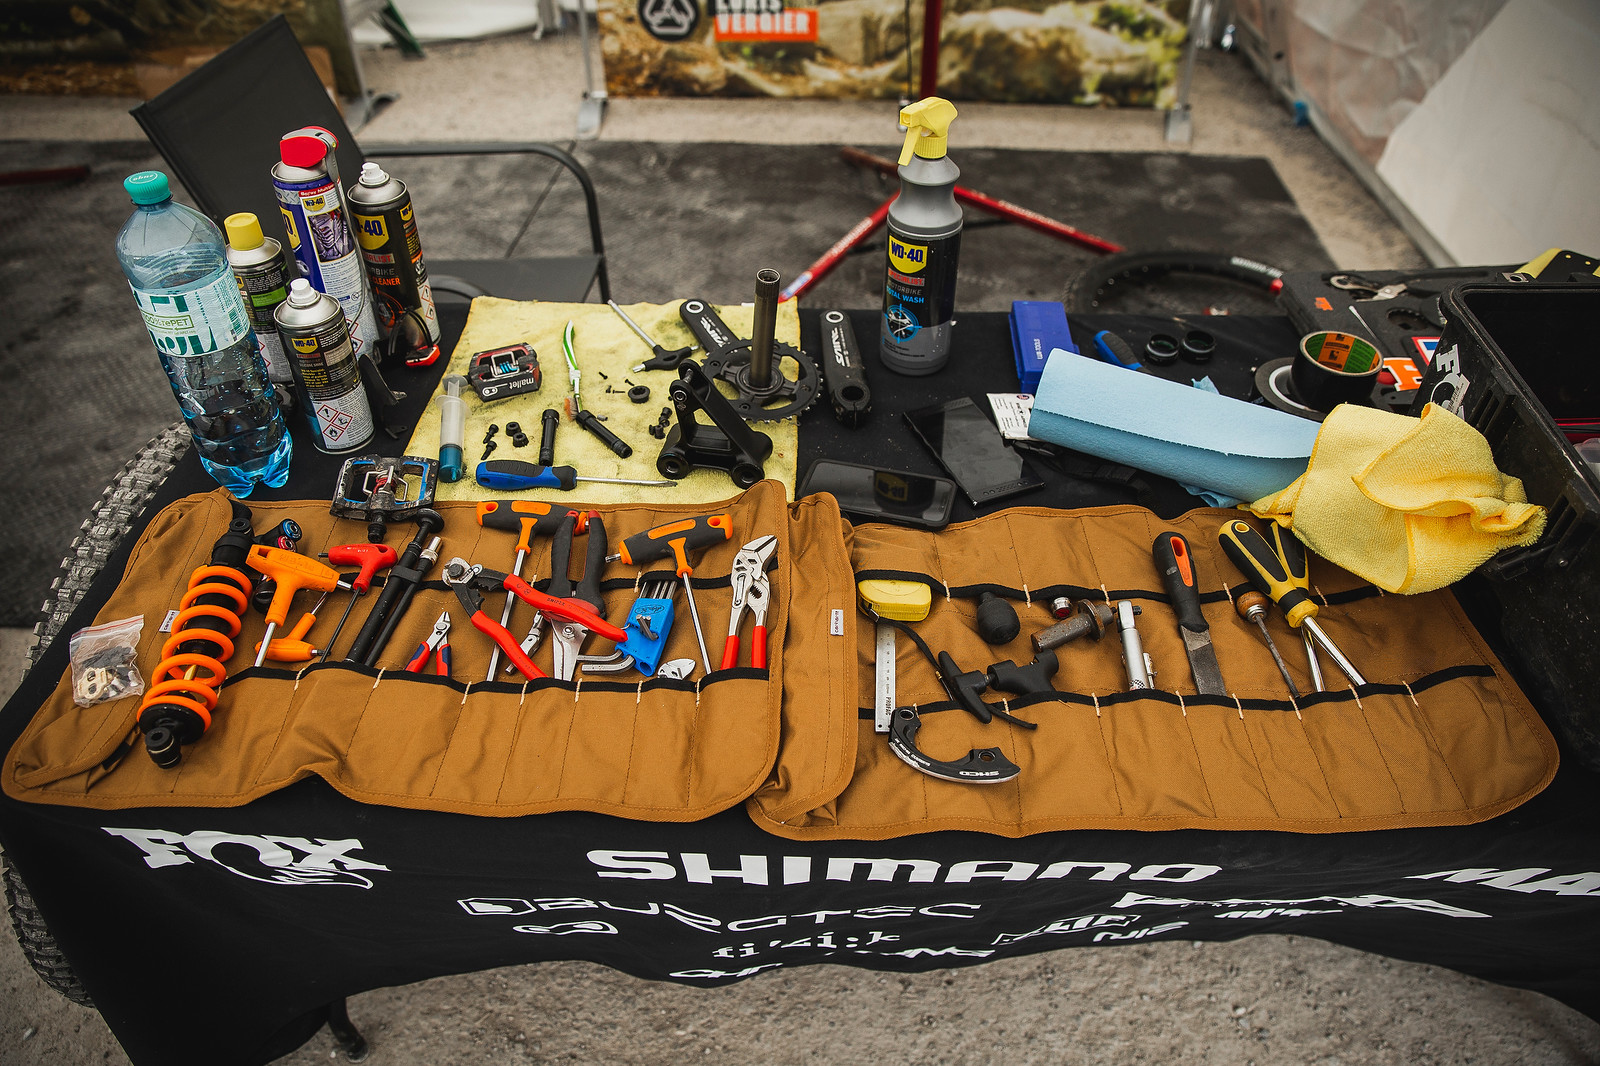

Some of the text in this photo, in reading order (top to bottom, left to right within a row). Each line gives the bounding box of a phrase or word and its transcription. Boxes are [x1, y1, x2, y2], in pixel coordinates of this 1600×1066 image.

[717, 12, 809, 34] VERGIER
[890, 240, 925, 264] WD-40
[888, 268, 925, 287] PECIALIST
[902, 294, 925, 304] WASH
[293, 339, 316, 348] WD-40
[509, 377, 534, 390] mallet
[100, 826, 392, 889] FOX
[586, 849, 1222, 886] SHIMANO
[1403, 867, 1600, 897] MA
